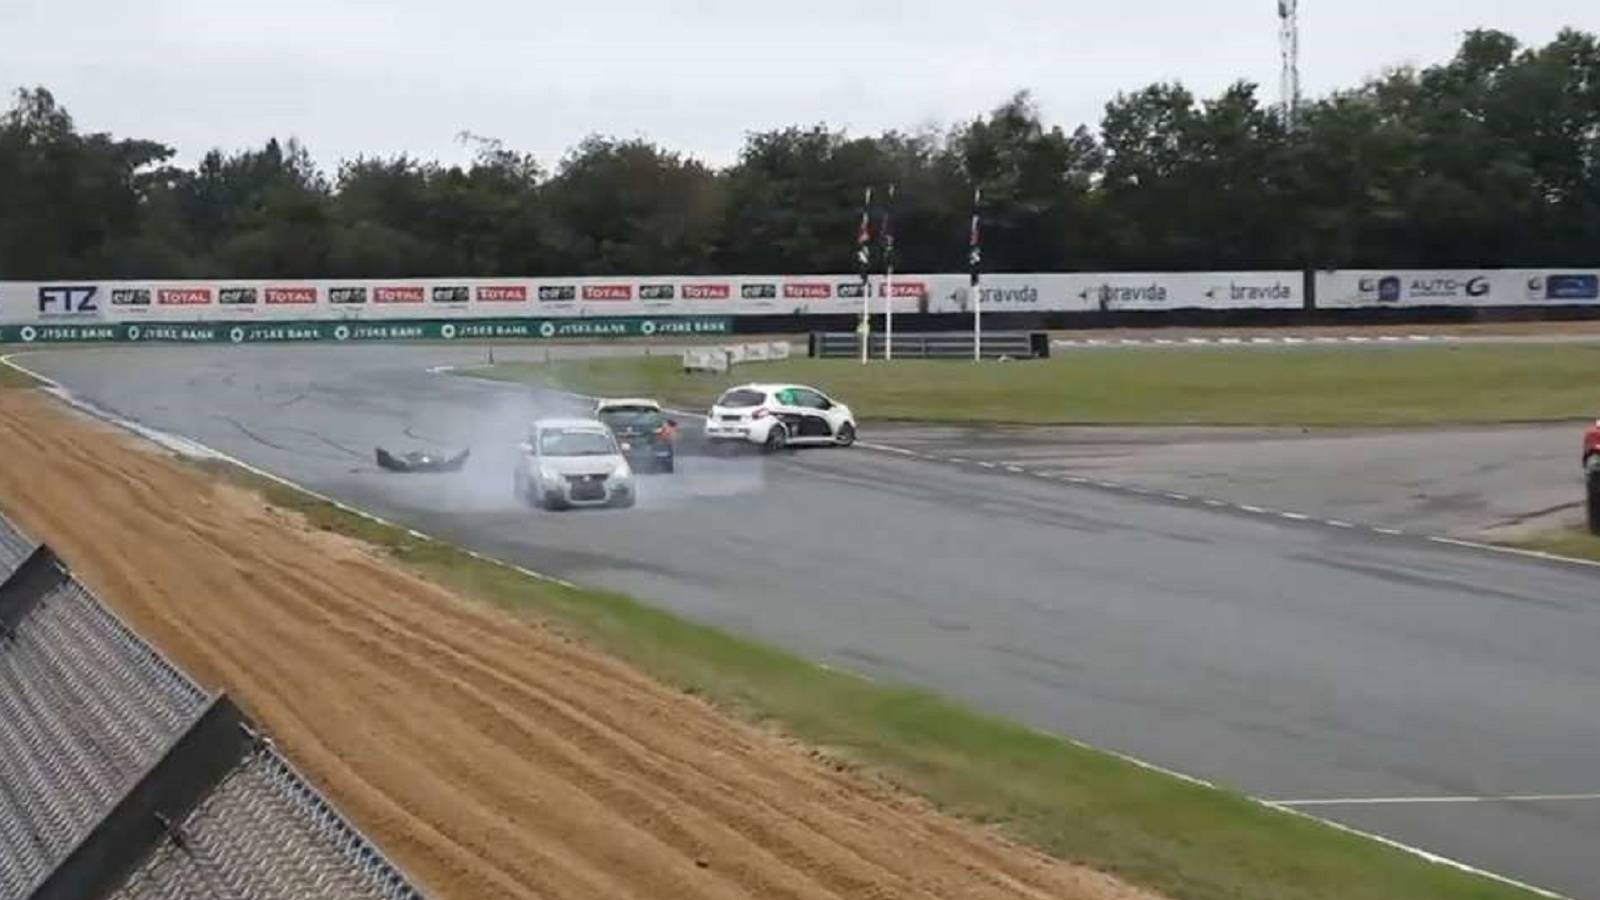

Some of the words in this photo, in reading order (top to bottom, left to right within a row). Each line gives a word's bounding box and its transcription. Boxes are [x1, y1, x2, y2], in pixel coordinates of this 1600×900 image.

[378, 290, 421, 301] TOTAL
[480, 289, 522, 300] TOTAL
[587, 287, 628, 299] TOTAL
[684, 287, 726, 298] TOTAL
[787, 286, 829, 297] TOTAL
[1231, 281, 1291, 299] bravida
[38, 286, 97, 311] FTZ
[163, 291, 207, 303] TOTAL
[270, 291, 312, 302] TOTAL
